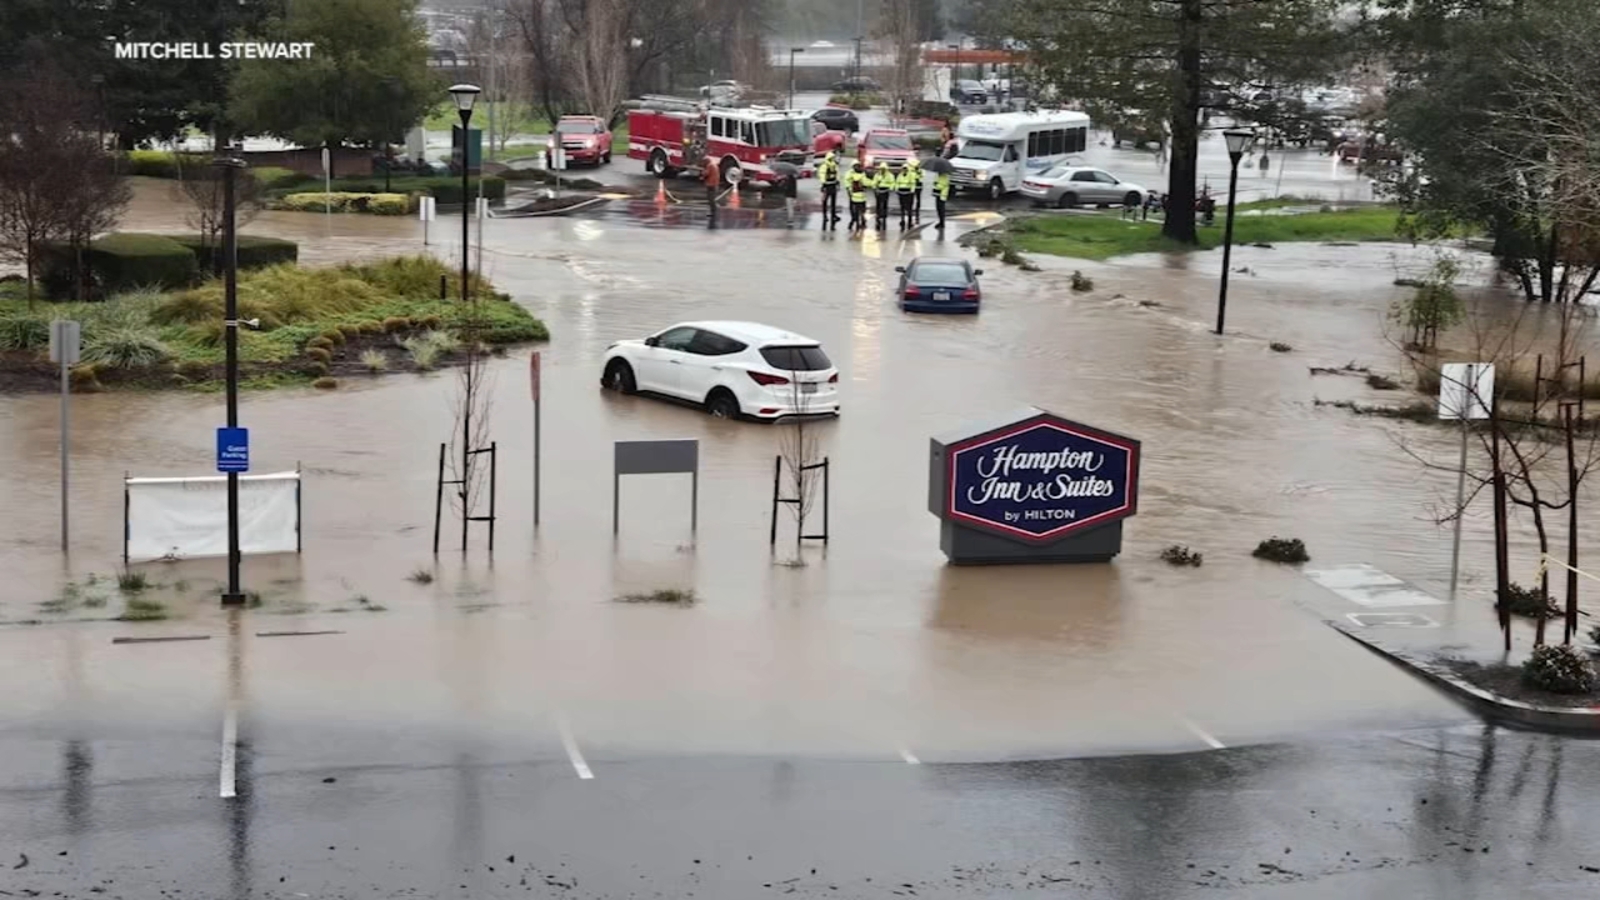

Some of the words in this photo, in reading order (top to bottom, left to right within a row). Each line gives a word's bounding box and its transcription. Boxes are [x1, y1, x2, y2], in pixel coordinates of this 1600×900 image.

[977, 445, 1104, 478] Hampton
[967, 476, 1031, 505] Inn
[1031, 482, 1047, 501] &
[1046, 473, 1114, 500] Suites
[1004, 510, 1020, 522] by
[1024, 509, 1076, 520] HILTON
